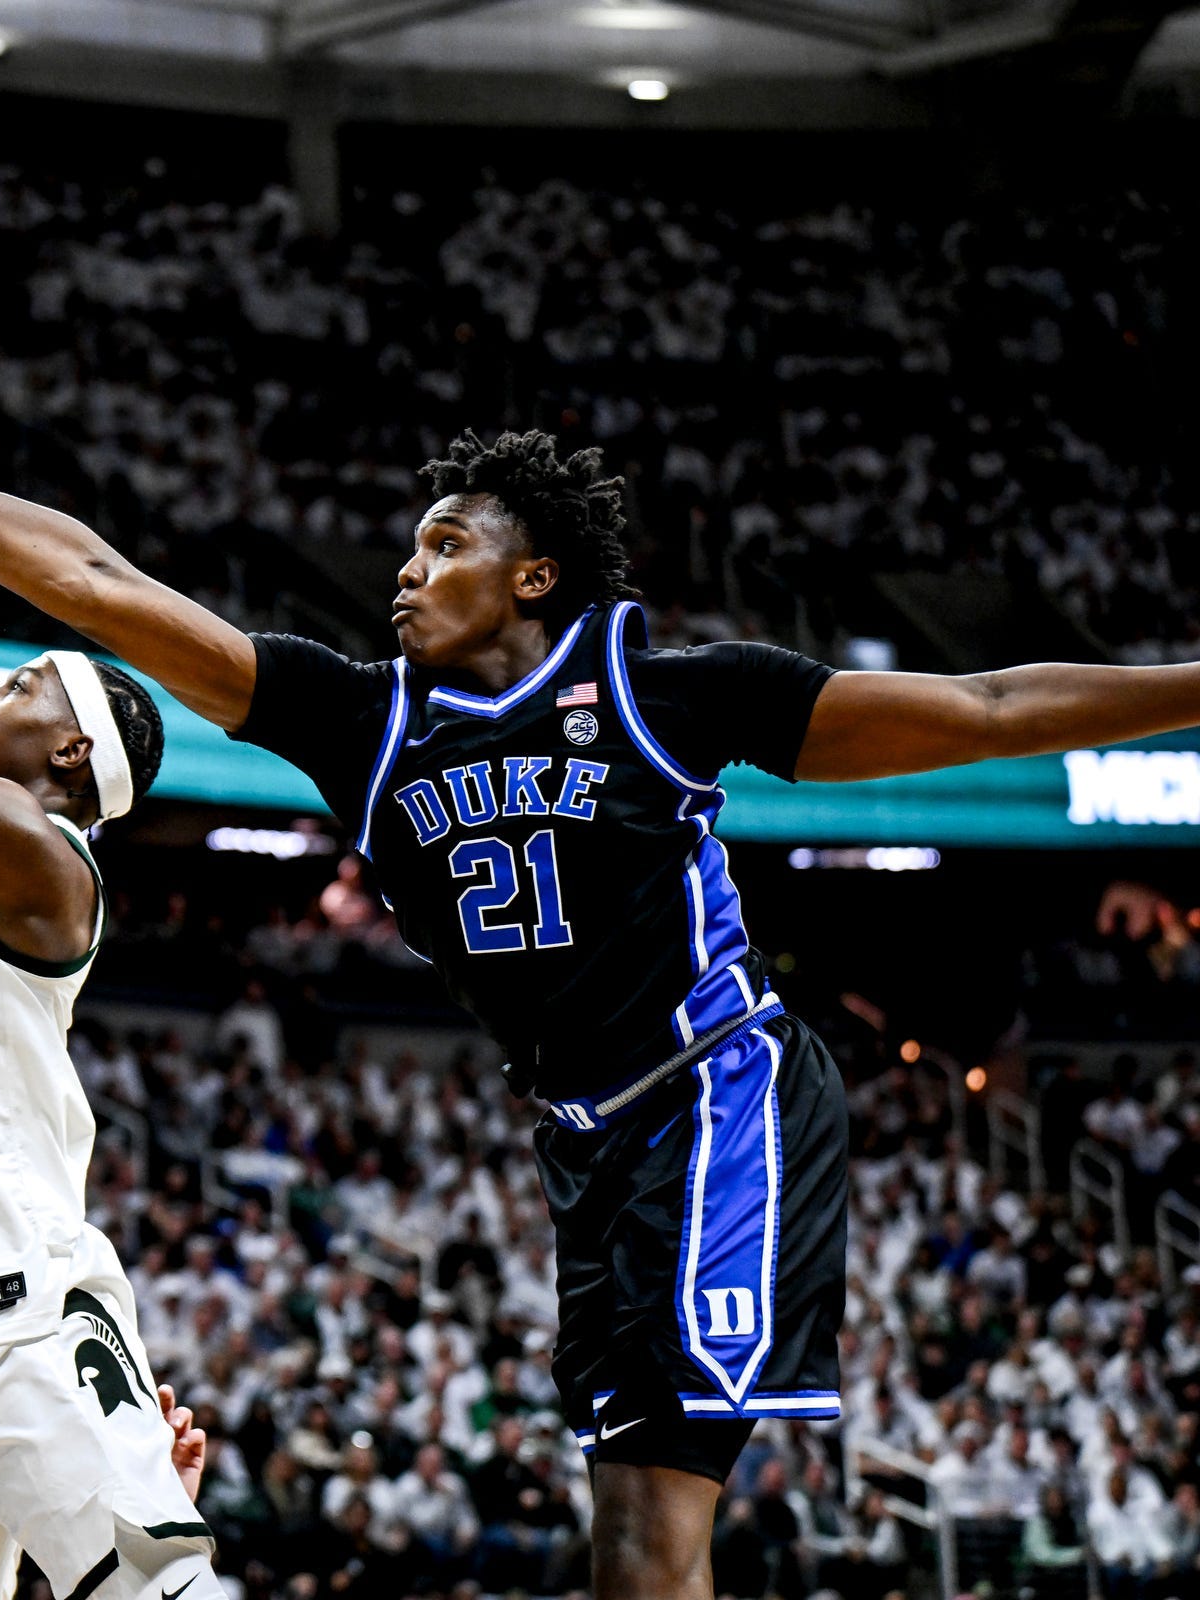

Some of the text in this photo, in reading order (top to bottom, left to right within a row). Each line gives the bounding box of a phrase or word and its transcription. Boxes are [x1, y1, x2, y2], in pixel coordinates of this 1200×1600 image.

[570, 721, 594, 730] ACC
[393, 757, 610, 847] DUKE
[448, 829, 574, 954] 21
[6, 1280, 20, 1292] 48
[701, 1287, 755, 1337] D
